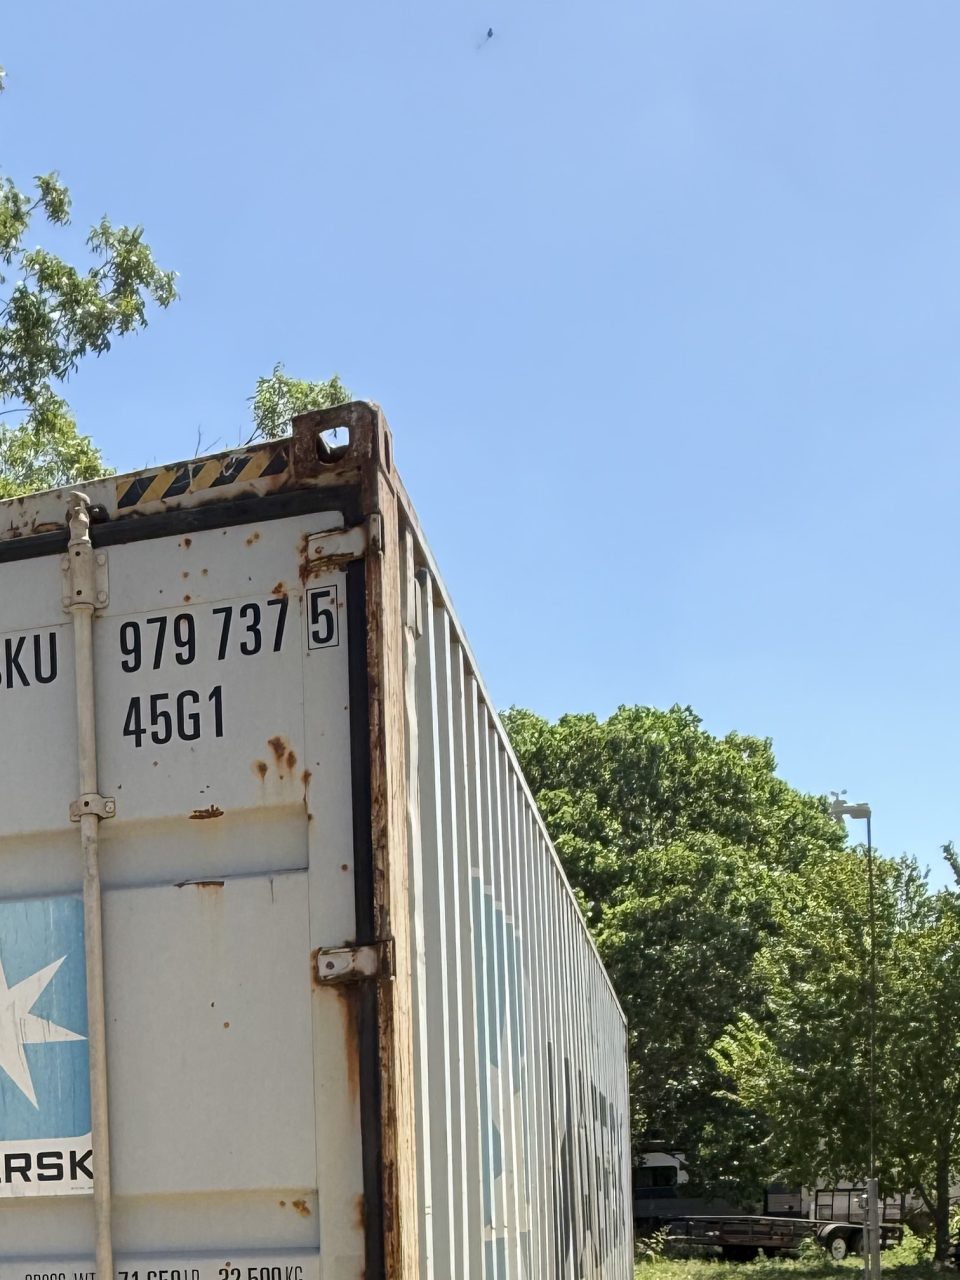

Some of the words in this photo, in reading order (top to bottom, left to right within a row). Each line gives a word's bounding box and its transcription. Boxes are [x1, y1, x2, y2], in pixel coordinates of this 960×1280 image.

[119, 606, 196, 674] 979
[212, 597, 290, 660] 737
[310, 590, 335, 645] 5
[122, 685, 224, 748] 45G1
